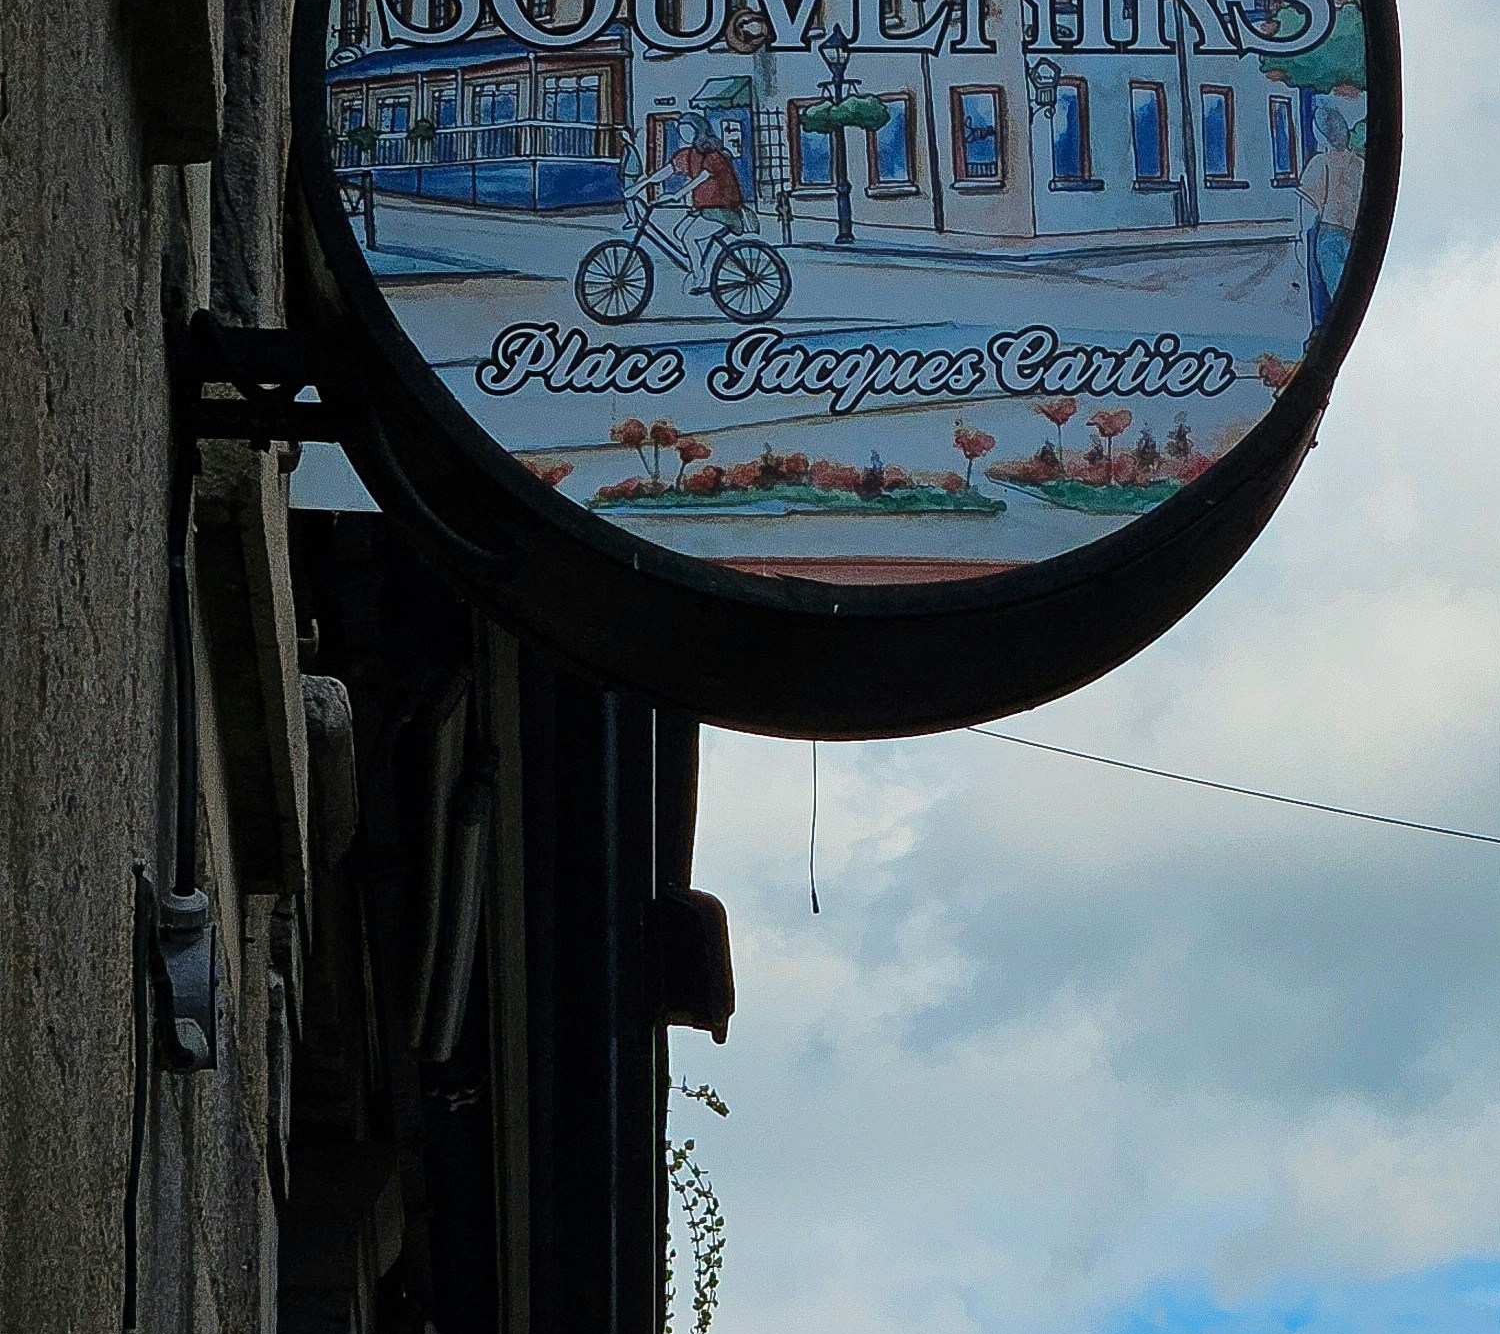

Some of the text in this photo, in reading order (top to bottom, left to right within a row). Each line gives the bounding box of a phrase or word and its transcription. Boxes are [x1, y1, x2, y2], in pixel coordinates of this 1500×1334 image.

[478, 323, 1237, 414] Place Jacques Cartier
